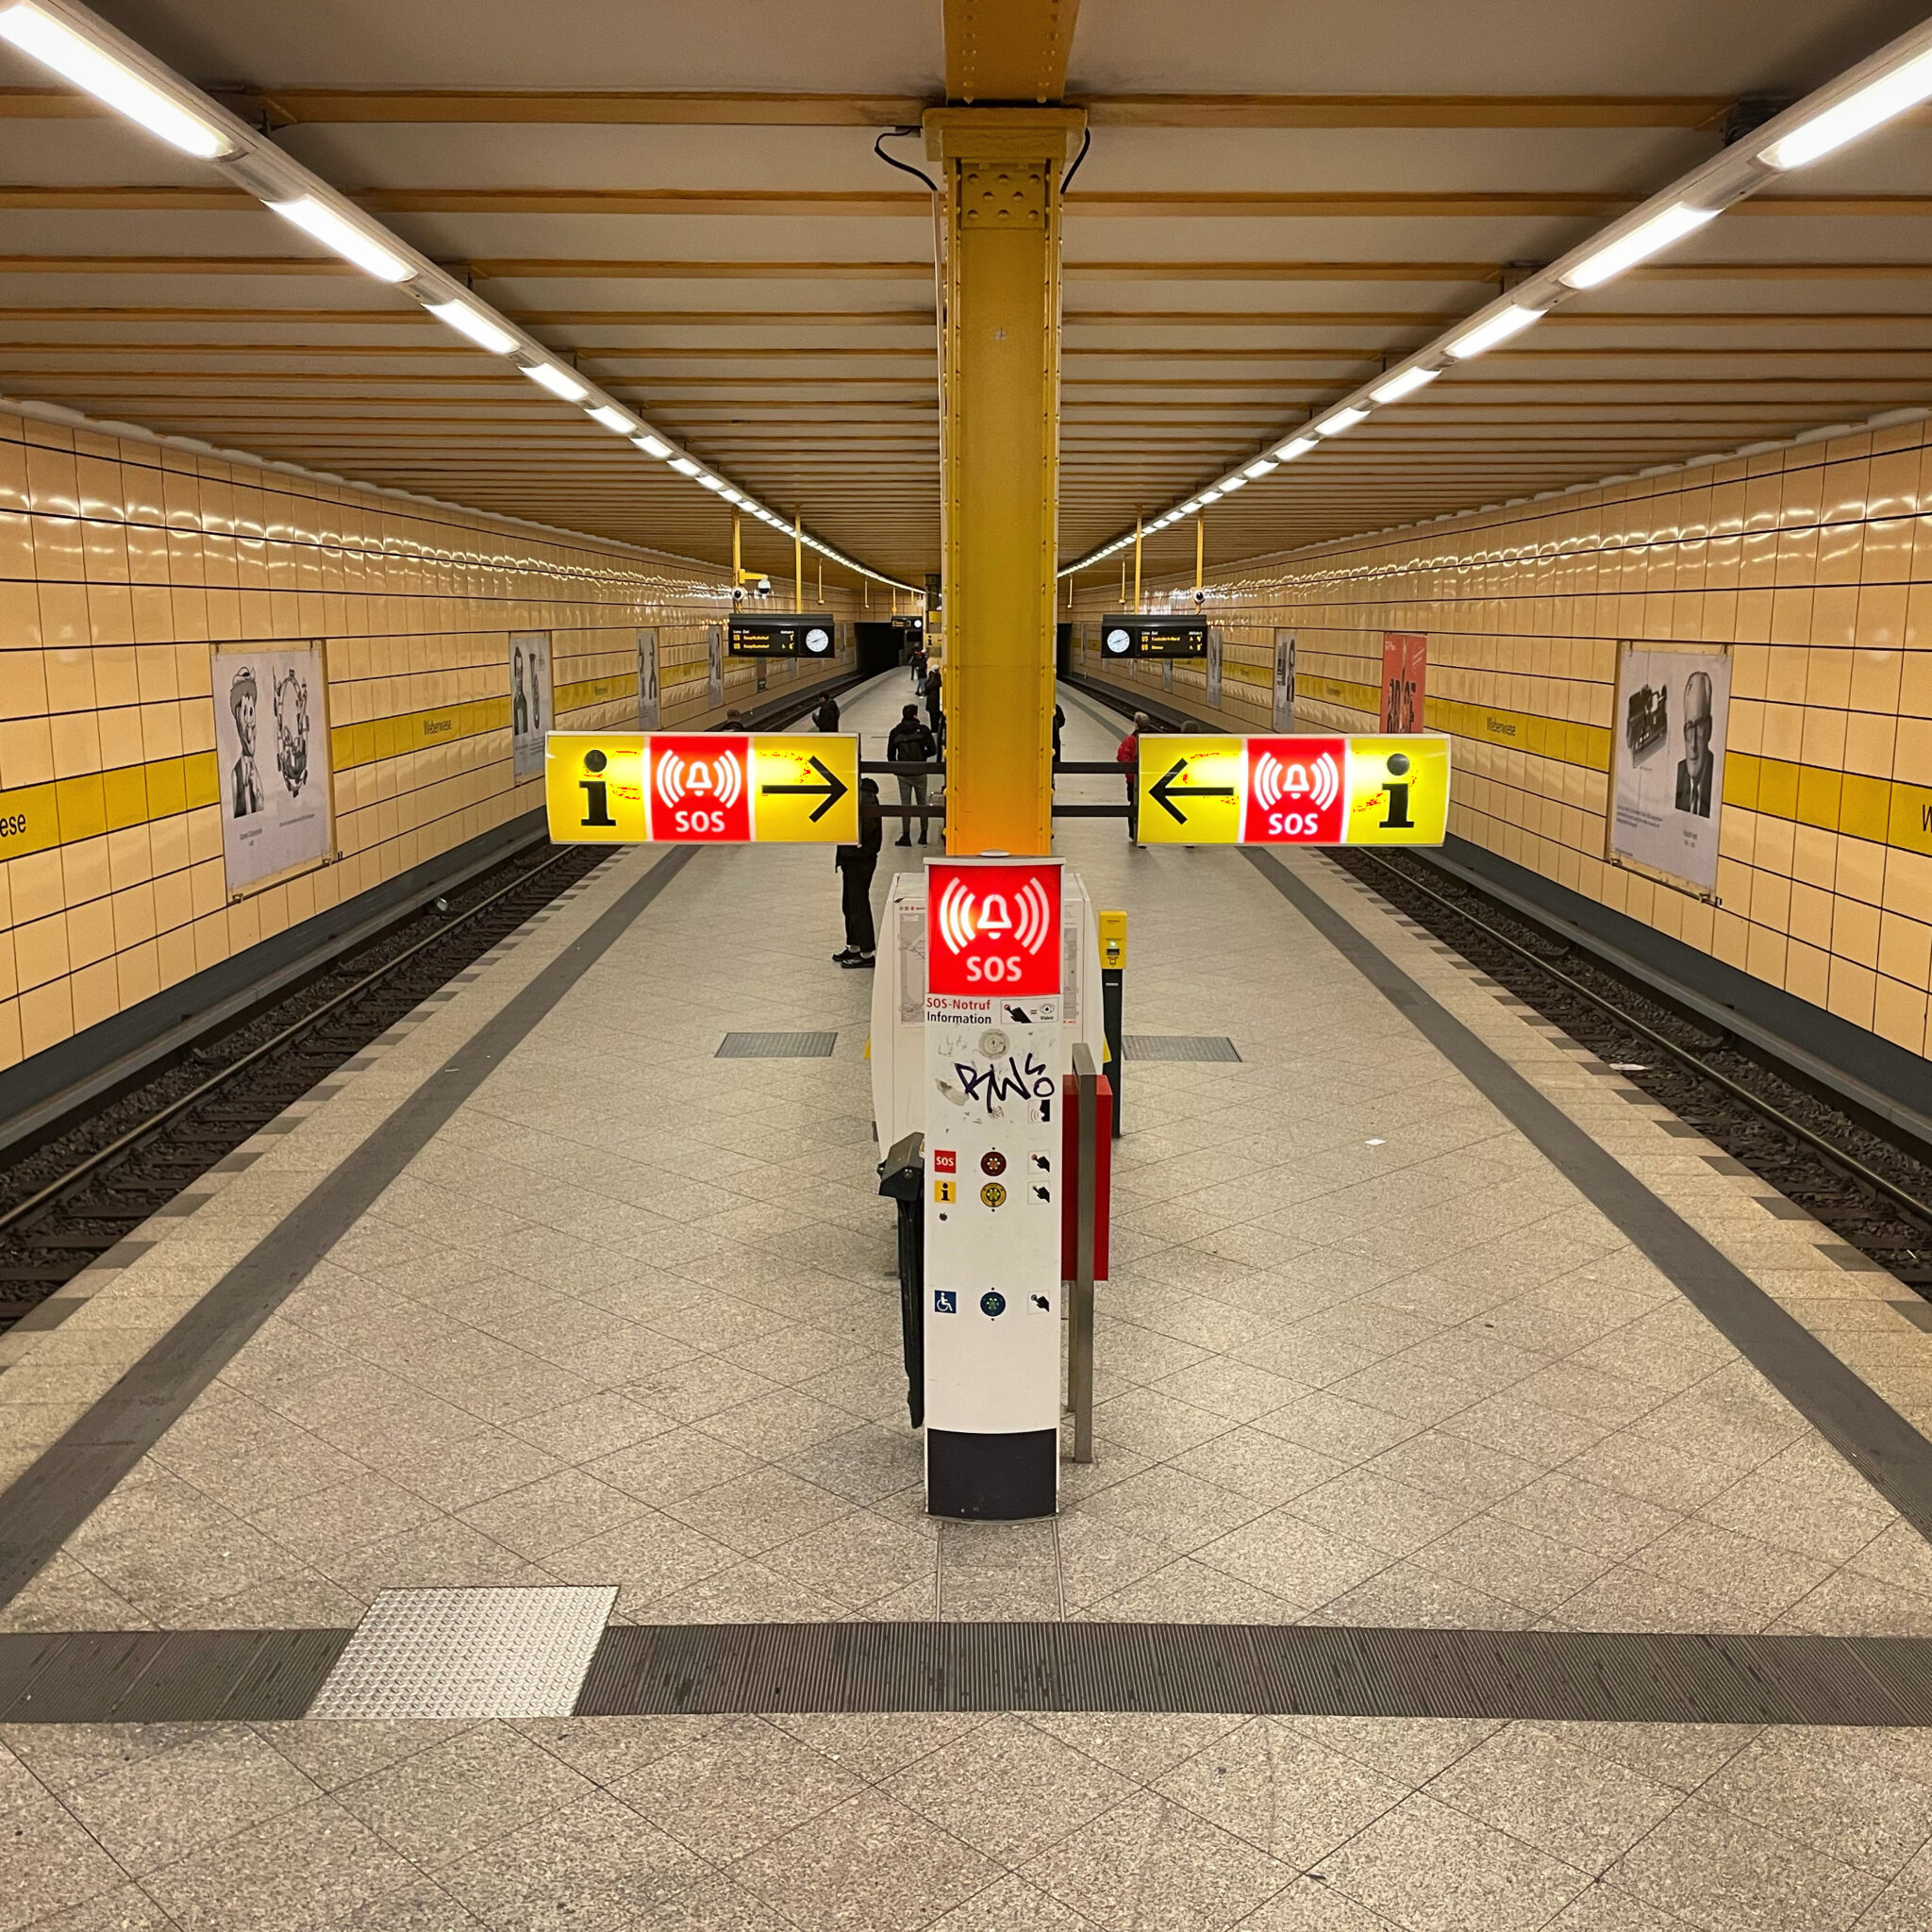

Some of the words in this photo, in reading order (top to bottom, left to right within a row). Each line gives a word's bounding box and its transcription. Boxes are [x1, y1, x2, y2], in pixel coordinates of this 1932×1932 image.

[675, 810, 725, 833] SOS
[1268, 813, 1319, 835] SOS
[966, 956, 1022, 982] SOS
[926, 997, 991, 1010] SOS-Notruf
[926, 1010, 991, 1024] Information
[936, 1156, 955, 1167] SOS
